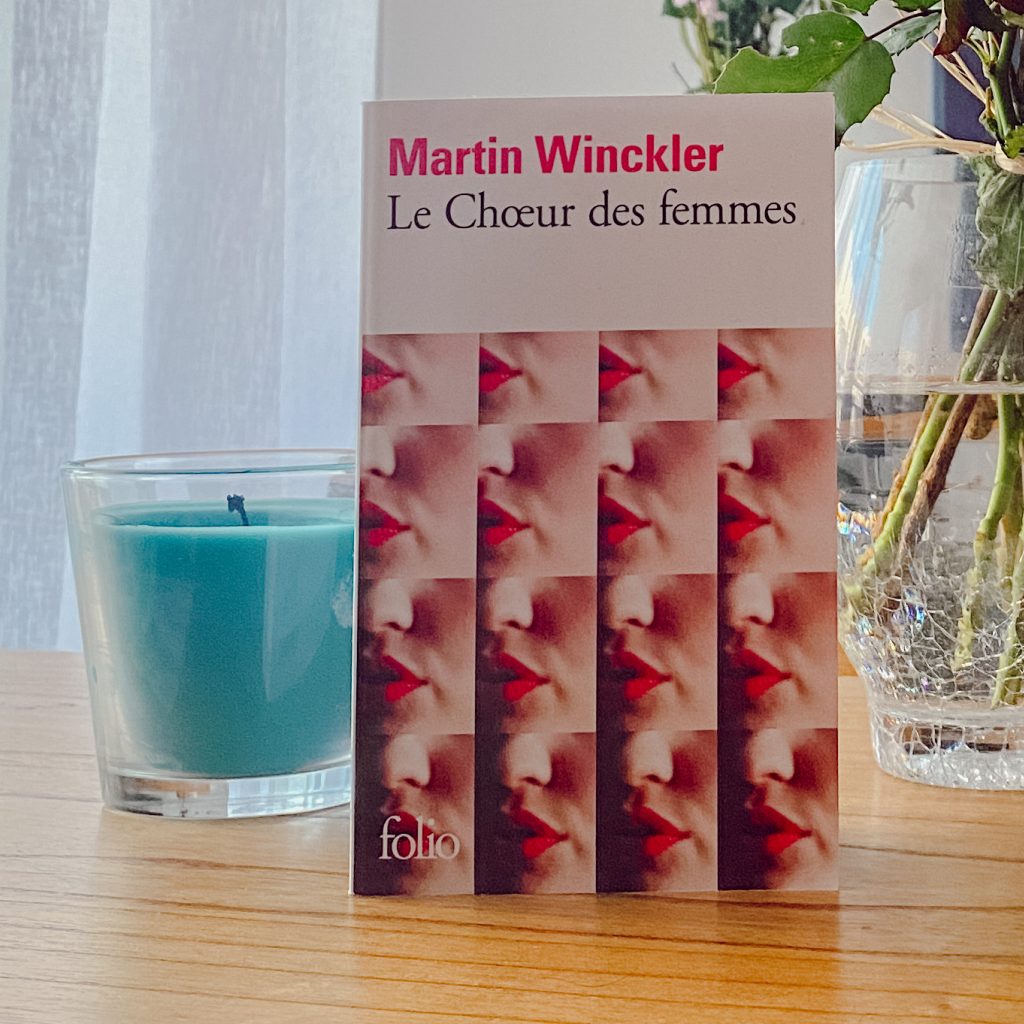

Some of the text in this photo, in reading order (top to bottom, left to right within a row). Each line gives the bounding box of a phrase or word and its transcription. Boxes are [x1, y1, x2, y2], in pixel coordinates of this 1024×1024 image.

[388, 132, 725, 177] Martin Winckler
[387, 187, 797, 230] Le Chœur des femmes
[378, 815, 461, 860] folio
